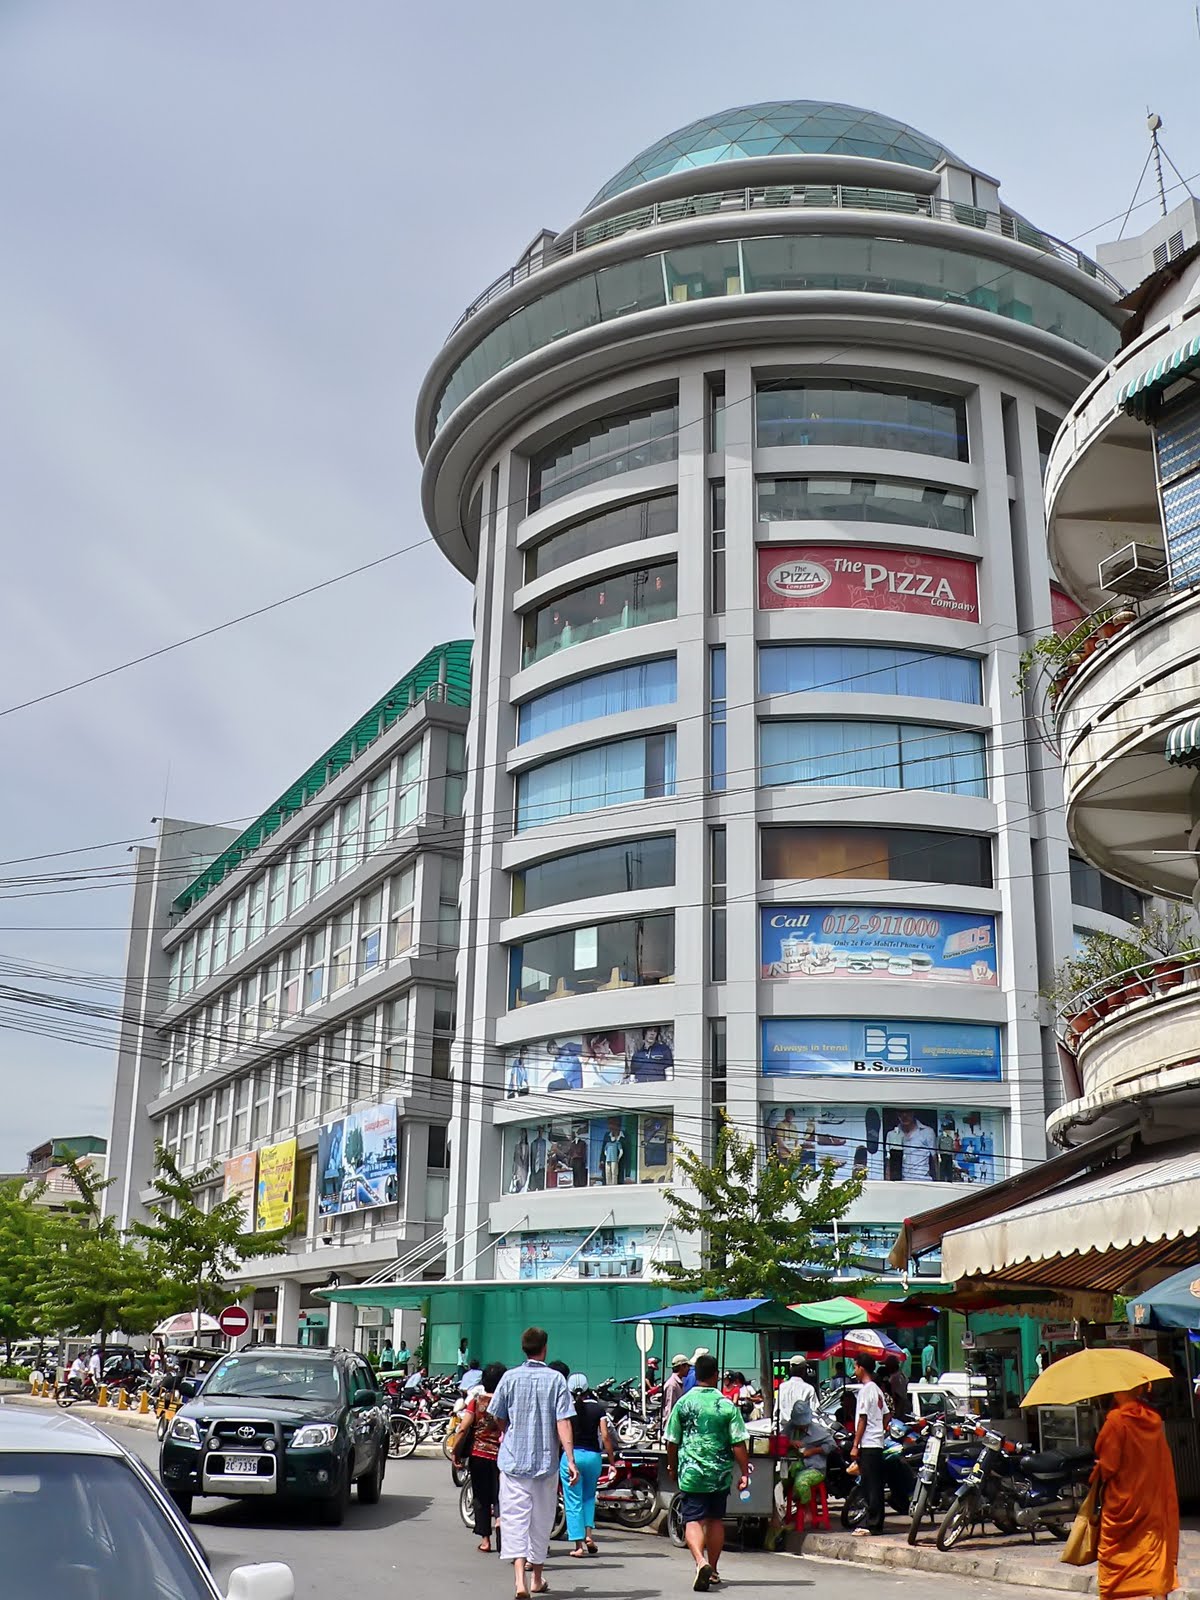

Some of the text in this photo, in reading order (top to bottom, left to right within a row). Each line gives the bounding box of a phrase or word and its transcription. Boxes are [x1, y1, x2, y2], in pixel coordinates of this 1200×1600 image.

[834, 558, 862, 573] The
[780, 571, 821, 582] PIZZA
[863, 564, 955, 600] PIZZA
[930, 597, 976, 612] Company
[770, 914, 940, 938] Call 012-911000
[773, 1044, 808, 1053] Always
[822, 1044, 848, 1052] trend
